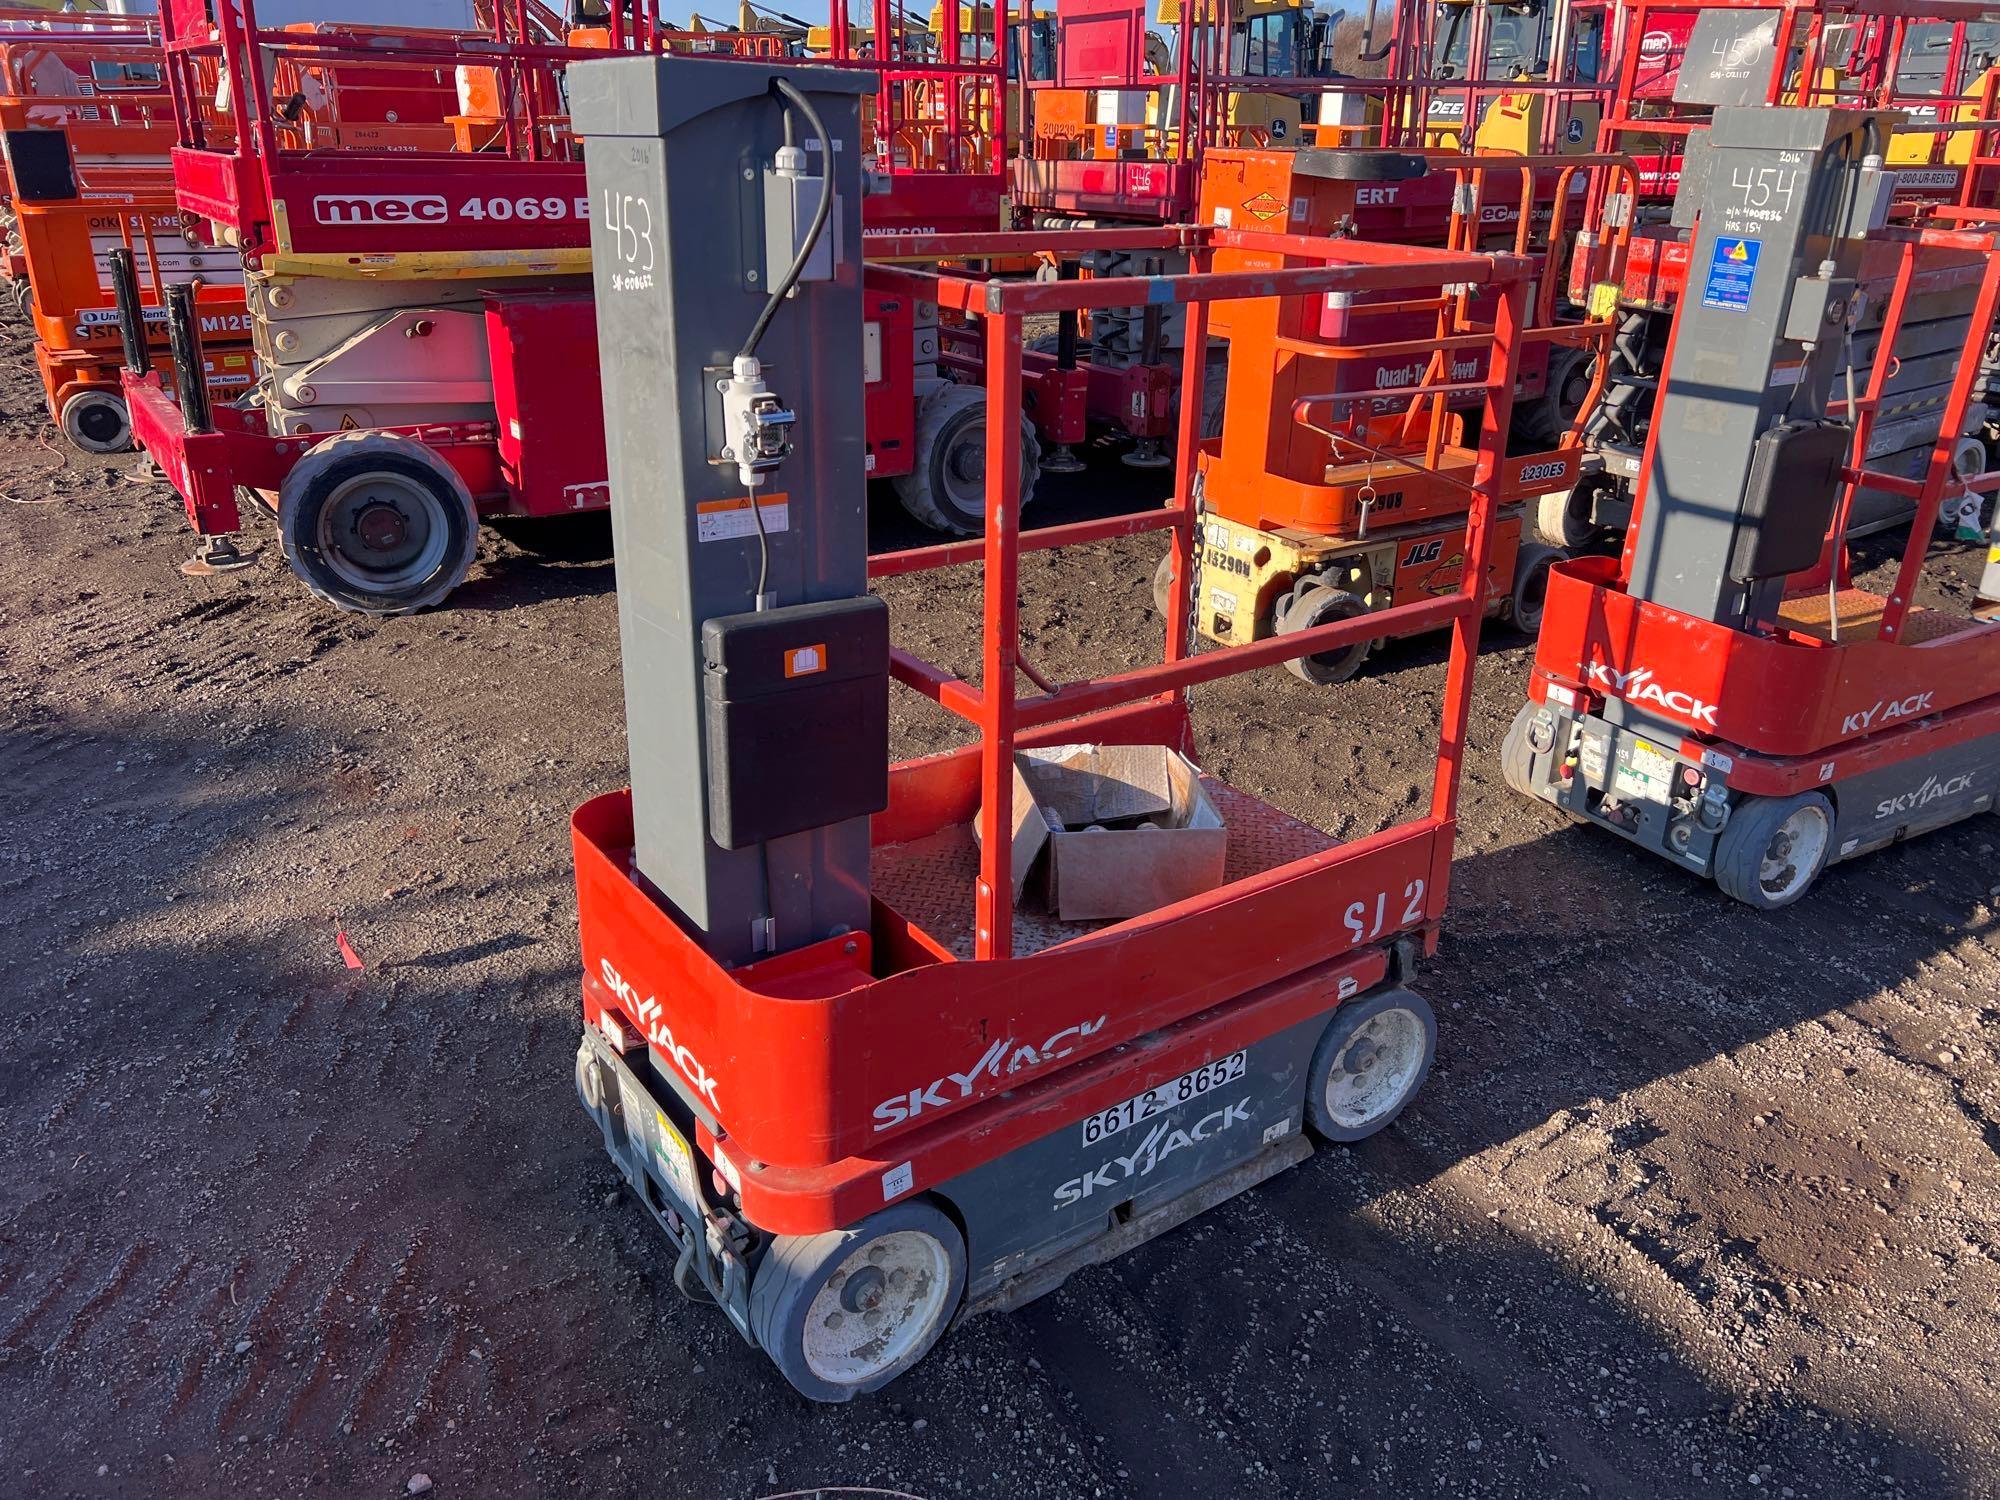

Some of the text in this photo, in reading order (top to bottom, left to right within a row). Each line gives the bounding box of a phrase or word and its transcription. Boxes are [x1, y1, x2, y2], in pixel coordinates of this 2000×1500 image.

[1711, 38, 1762, 67] 450
[1043, 122, 1076, 136] 200239
[1131, 168, 1151, 186] 446
[1732, 167, 1797, 213] 454
[315, 197, 448, 223] mec
[459, 197, 567, 220] 4069
[1356, 187, 1399, 205] ERT
[604, 188, 653, 270] 453
[1745, 221, 1761, 233] 154
[1520, 461, 1566, 482] 1230ES
[1401, 539, 1444, 568] JLG
[1874, 772, 1976, 819] SKYJACK
[600, 957, 721, 1114] SKYJACK
[1085, 1051, 1246, 1144] 6612 8652
[1052, 1095, 1254, 1211] SKYJACK
